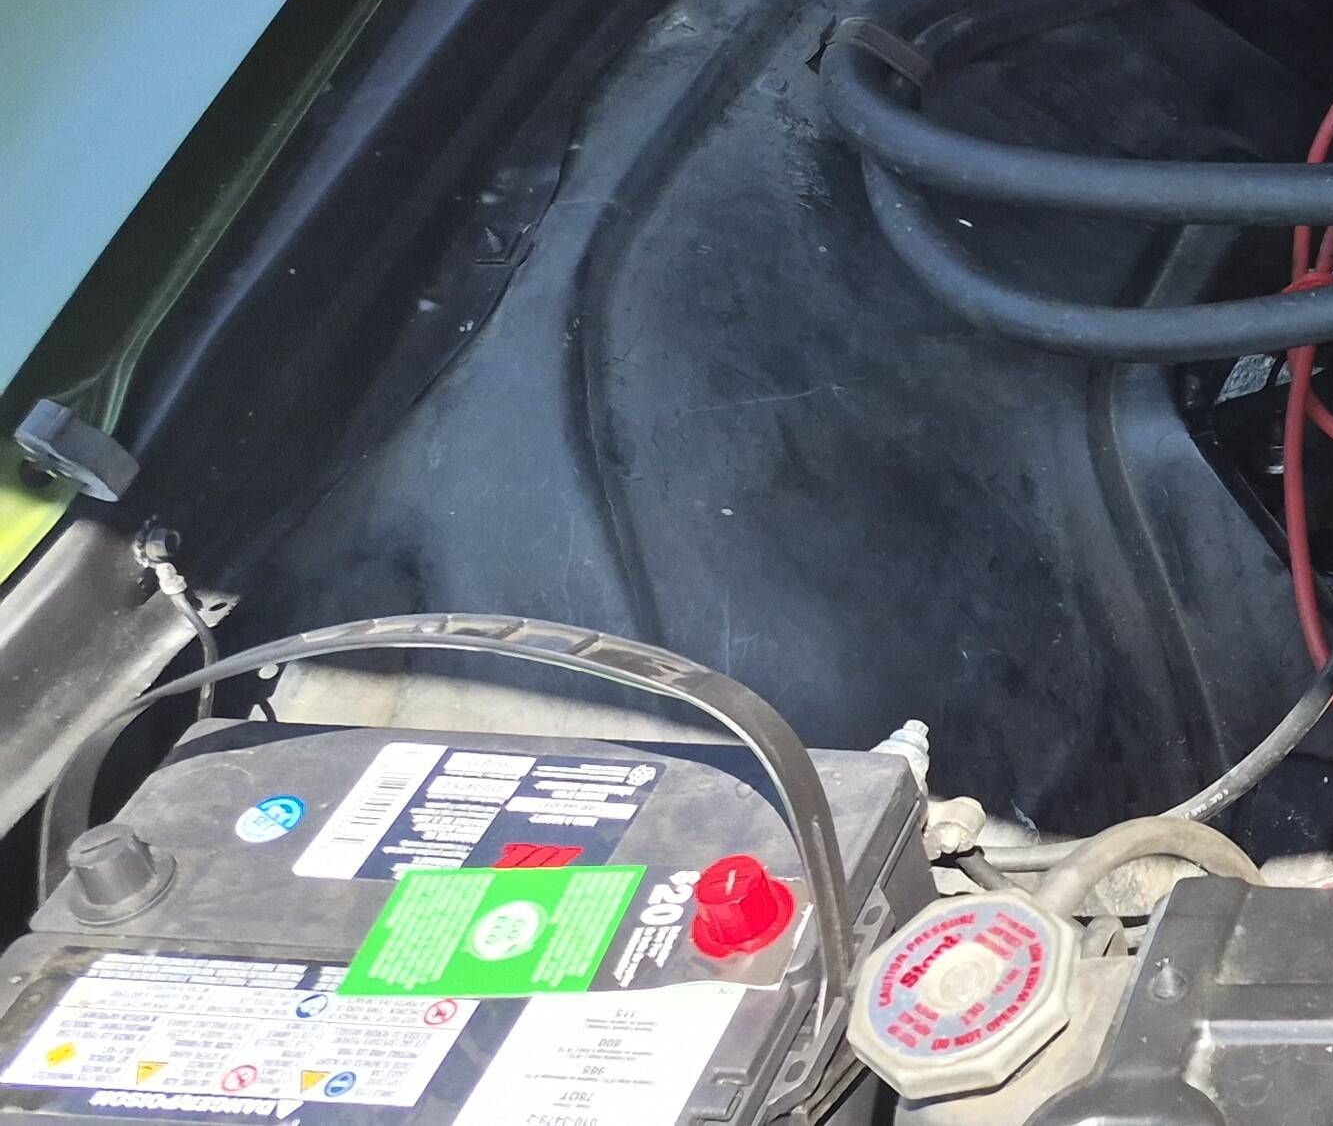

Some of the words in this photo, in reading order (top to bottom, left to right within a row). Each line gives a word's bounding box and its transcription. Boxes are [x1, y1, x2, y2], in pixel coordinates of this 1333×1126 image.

[878, 953, 907, 1007] CAUTION
[906, 912, 976, 952] PRESSURE
[954, 1028, 983, 1047] NOT
[985, 1005, 1019, 1032] OPEN
[1017, 966, 1041, 1003] WHEN
